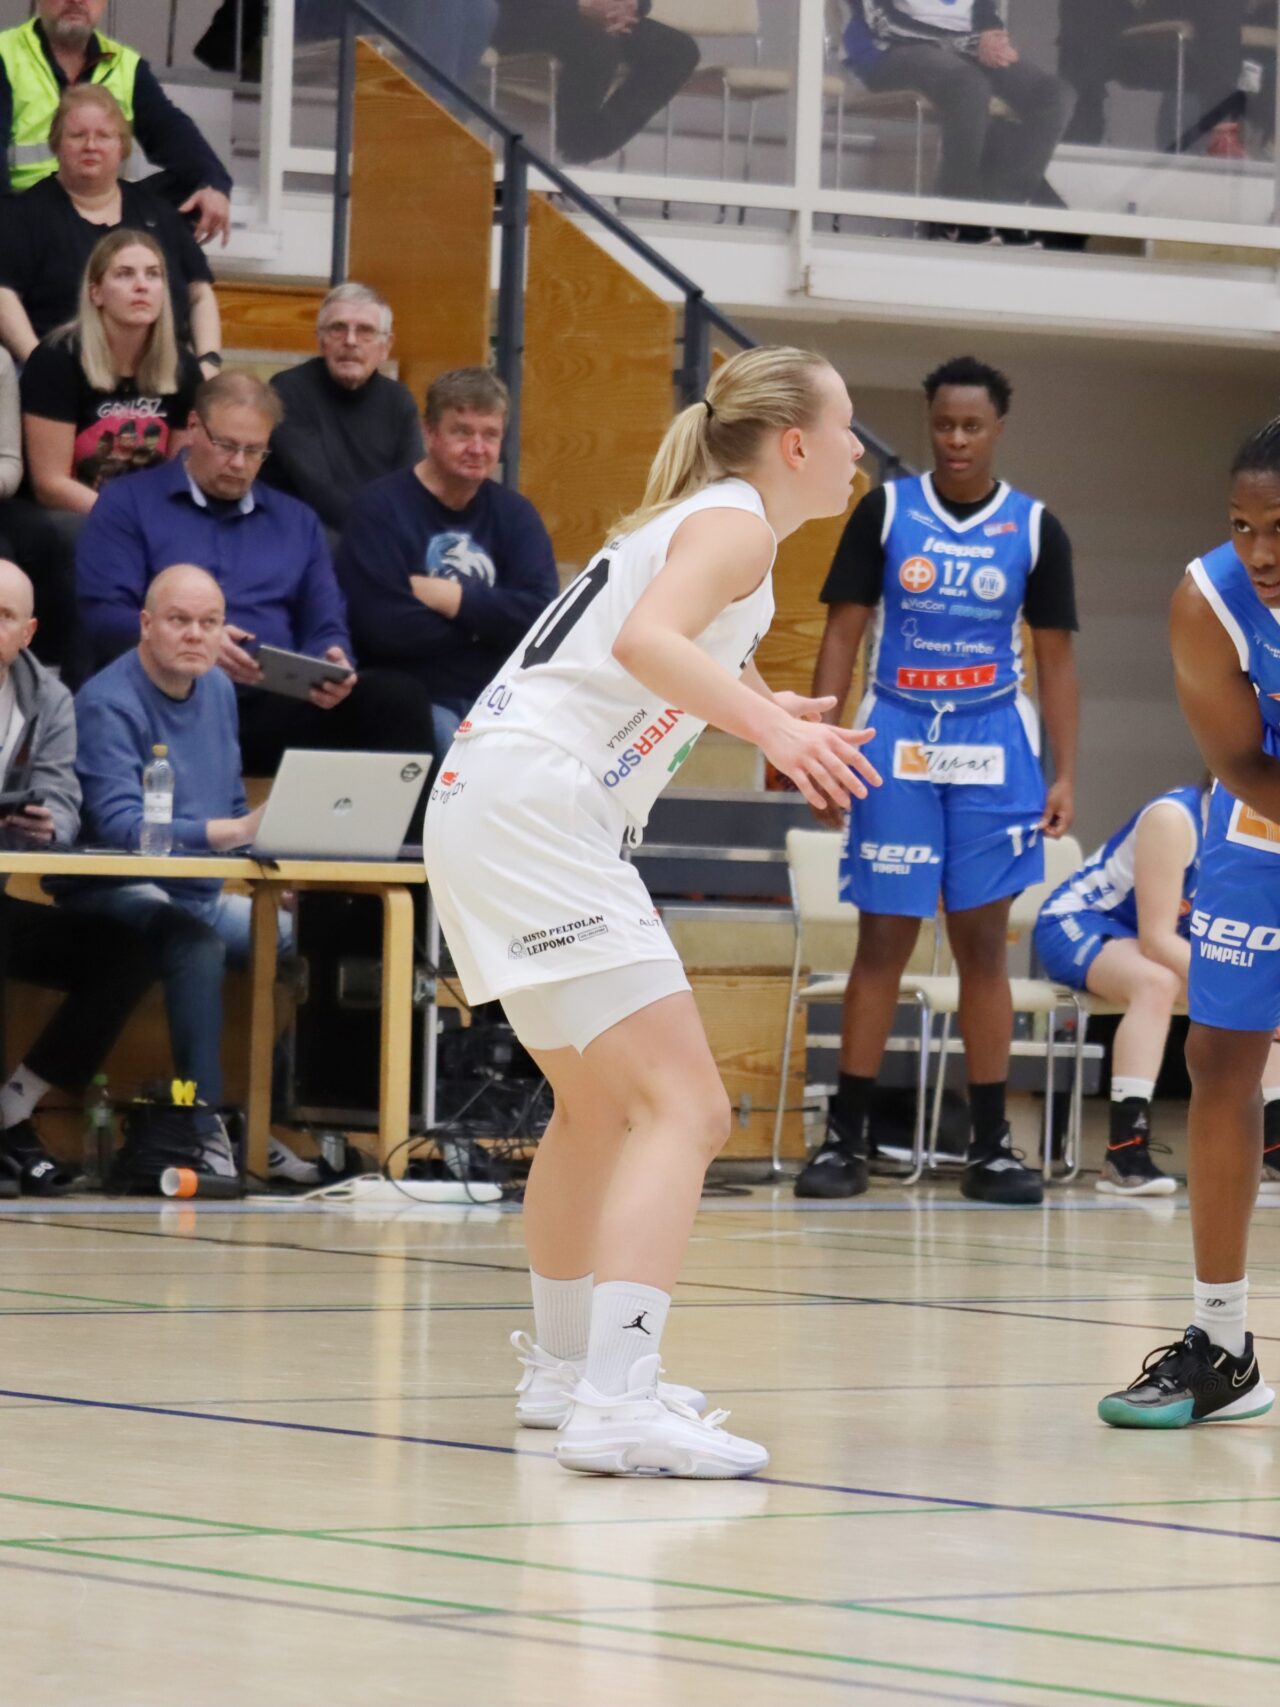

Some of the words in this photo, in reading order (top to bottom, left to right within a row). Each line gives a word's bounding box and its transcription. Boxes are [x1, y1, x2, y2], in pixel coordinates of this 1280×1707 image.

[943, 560, 971, 586] 17
[913, 638, 951, 652] Green
[954, 641, 995, 655] Timber
[607, 708, 648, 749] KOUVOLA
[522, 930, 547, 944] RISTO
[549, 914, 604, 936] PELTOLAN
[526, 935, 575, 957] LEIPOMO
[1200, 942, 1255, 968] VIMPELI
